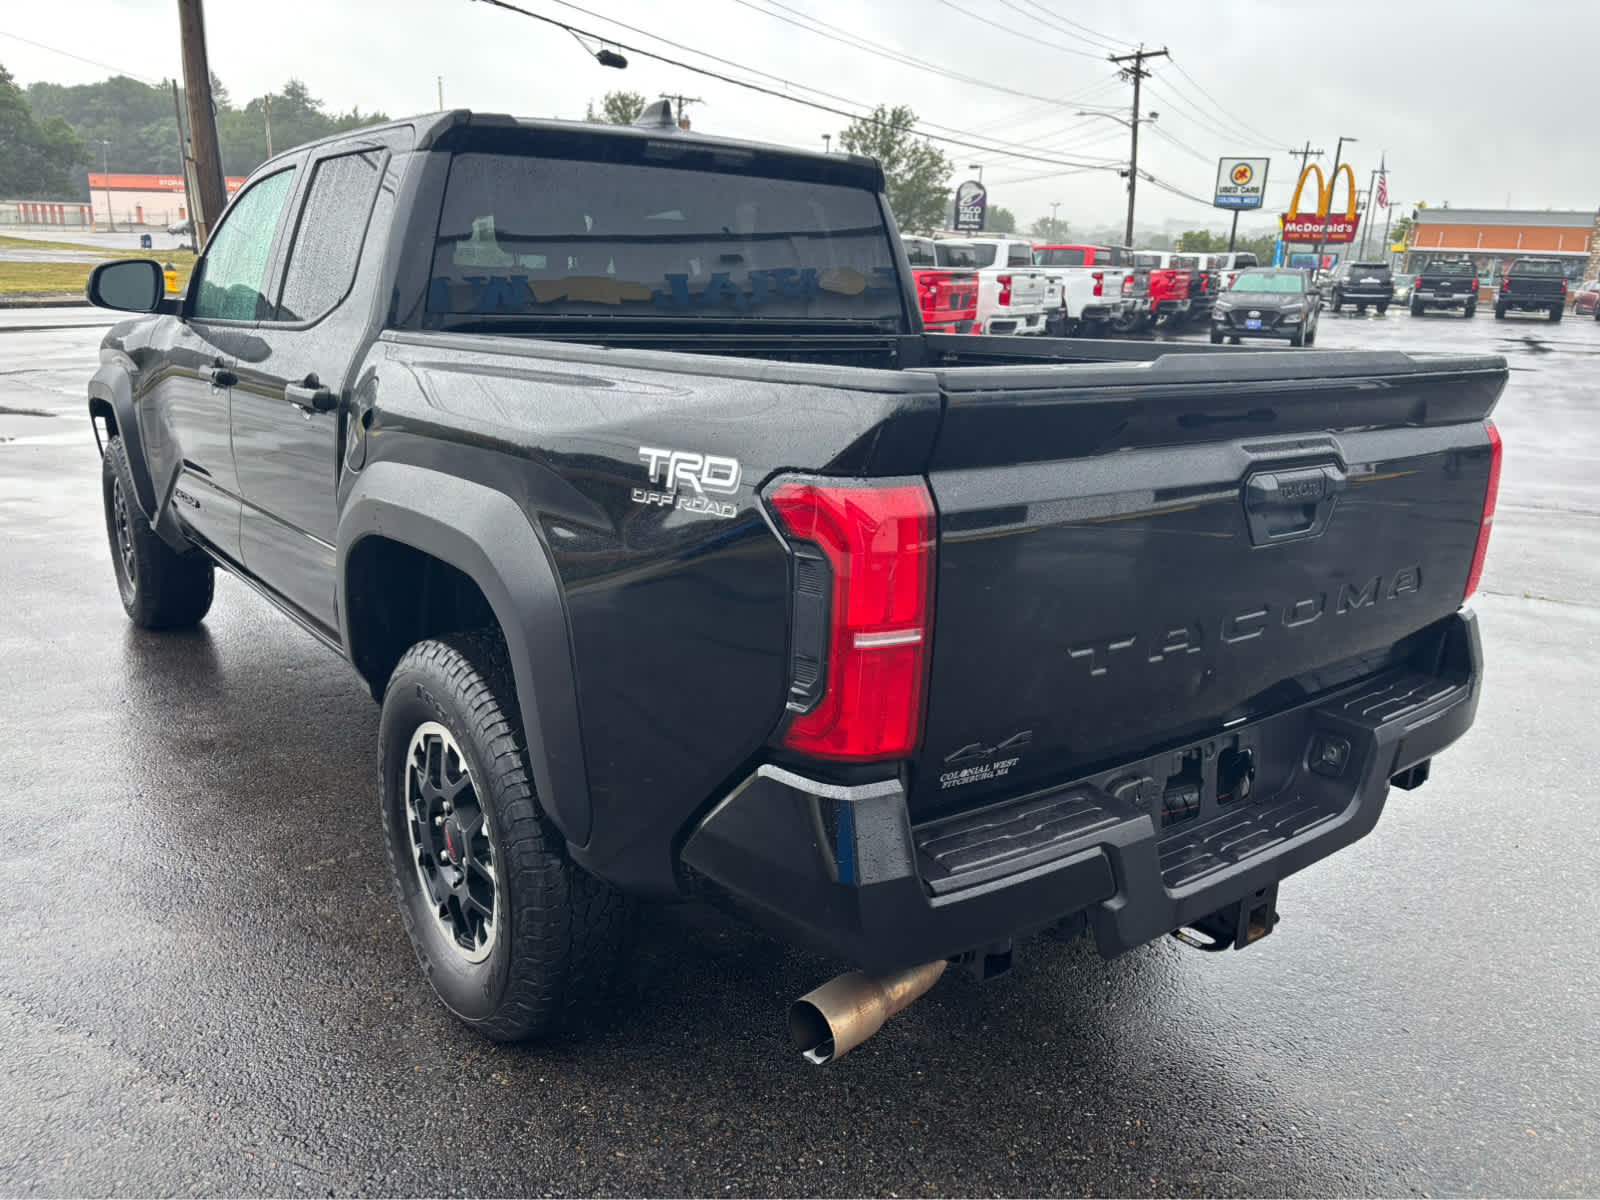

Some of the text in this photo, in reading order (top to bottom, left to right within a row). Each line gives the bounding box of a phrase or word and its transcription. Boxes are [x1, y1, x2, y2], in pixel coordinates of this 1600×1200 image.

[959, 206, 982, 214] TACO
[959, 213, 981, 222] BELL
[639, 446, 742, 494] TRD
[631, 487, 674, 506] OFF
[1067, 562, 1423, 676] TACOMA
[940, 757, 1020, 782] COLONIAL WEST
